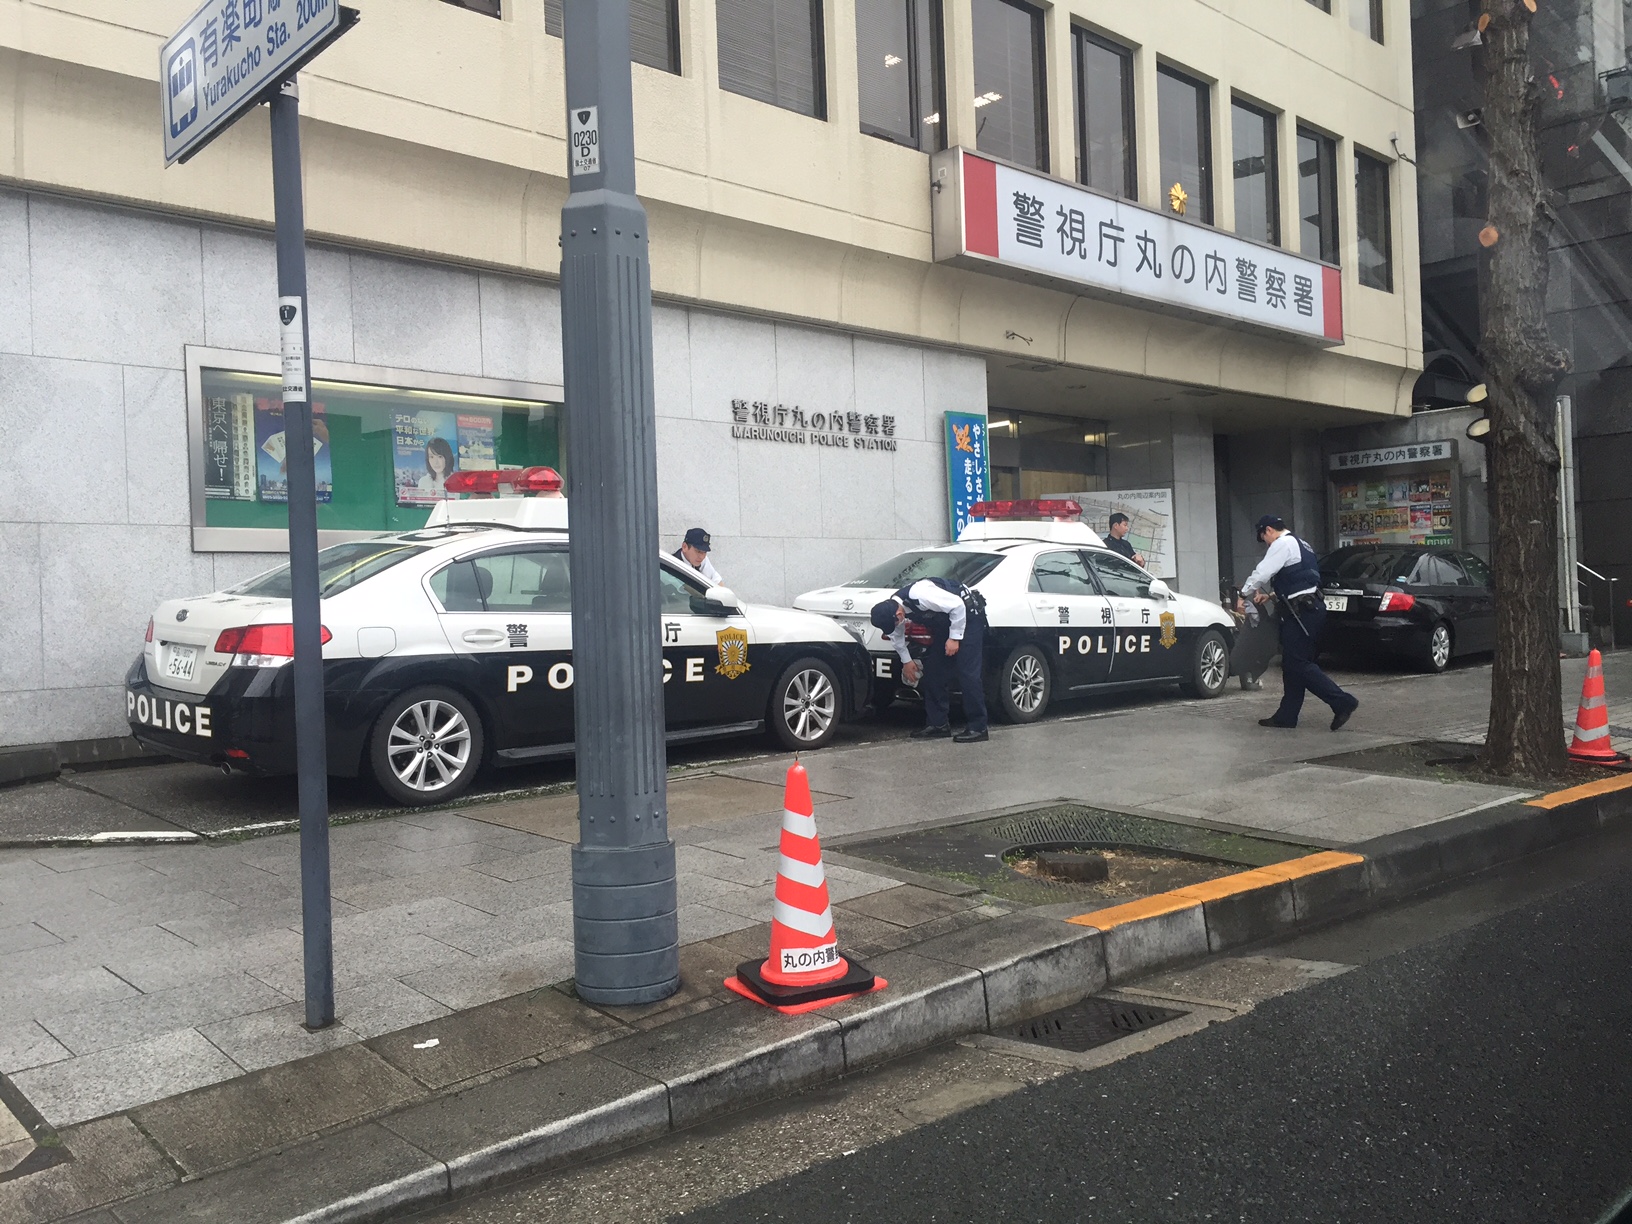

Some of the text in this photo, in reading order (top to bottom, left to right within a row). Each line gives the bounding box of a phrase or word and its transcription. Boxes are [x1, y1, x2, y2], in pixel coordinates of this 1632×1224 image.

[203, 45, 261, 111] Yurakucho
[266, 21, 291, 57] Sta.
[574, 130, 597, 147] 0230
[581, 146, 590, 157] D
[1013, 190, 1314, 318] 警視庁丸の内警察署
[731, 398, 897, 436] 警視庁丸の内警察署
[396, 436, 425, 446] 日本から
[810, 432, 849, 448] POLICE
[854, 437, 898, 452] STATION
[1338, 444, 1443, 467] 警視庁丸の内警察署
[1058, 606, 1150, 624] 警視庁
[719, 633, 745, 642] POLICE
[1058, 634, 1151, 655] POLICE
[127, 690, 212, 738] POLICE
